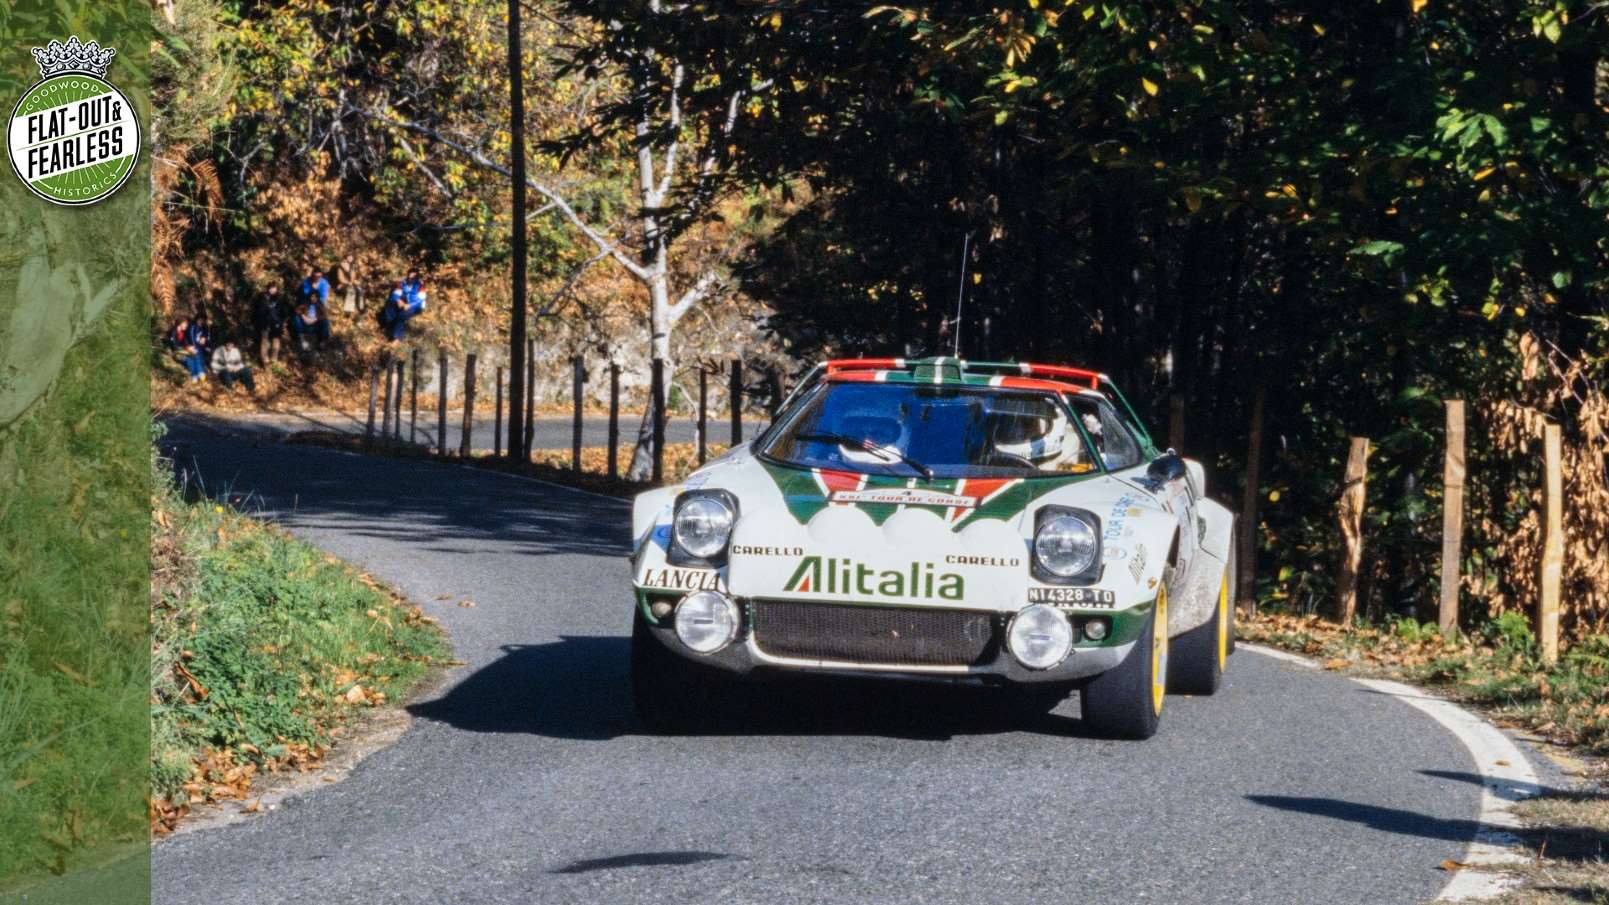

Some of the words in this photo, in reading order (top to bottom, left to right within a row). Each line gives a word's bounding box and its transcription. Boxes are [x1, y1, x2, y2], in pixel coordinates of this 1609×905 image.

[732, 545, 804, 556] CARELLO
[945, 554, 1020, 567] CARELLO
[643, 568, 720, 591] LANCIA
[783, 556, 965, 600] Alitalia
